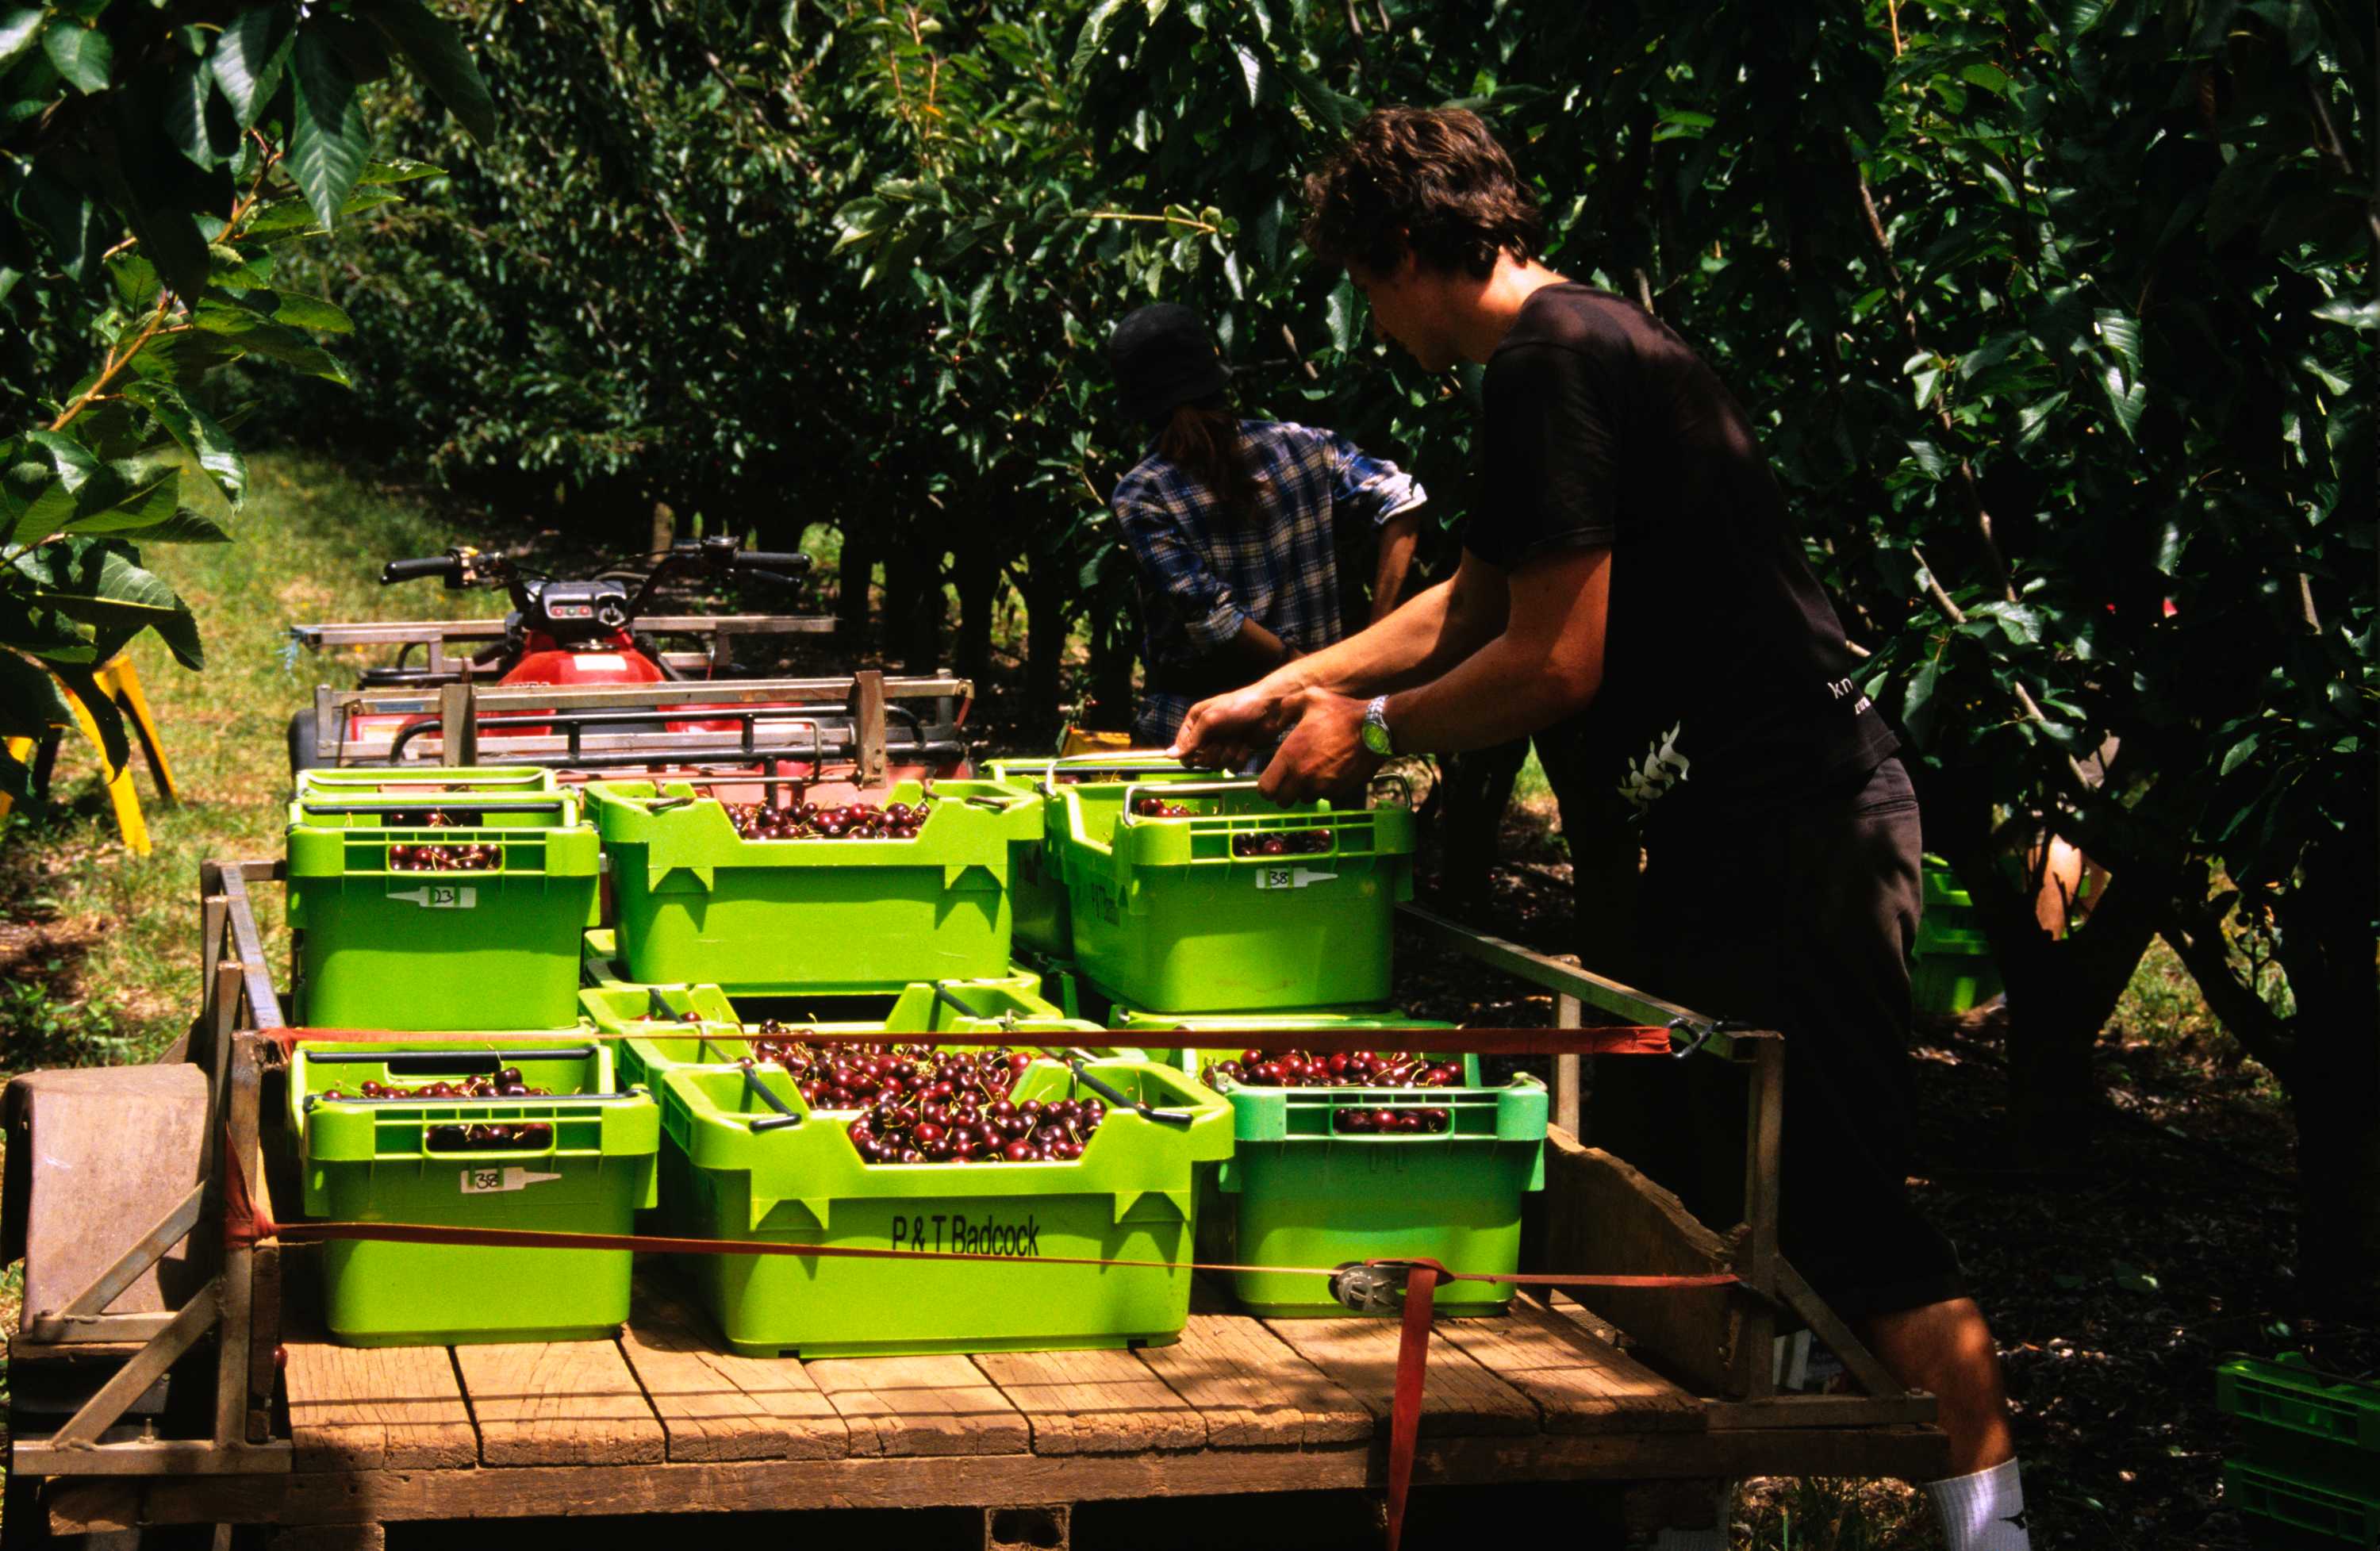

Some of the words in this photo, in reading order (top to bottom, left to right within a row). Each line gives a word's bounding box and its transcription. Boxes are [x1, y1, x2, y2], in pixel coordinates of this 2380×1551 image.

[1269, 871, 1288, 886] 38
[475, 1173, 498, 1189] 38
[892, 1215, 907, 1250] P
[912, 1215, 925, 1252] &
[931, 1215, 946, 1253] T
[952, 1214, 1040, 1257] Badcock
